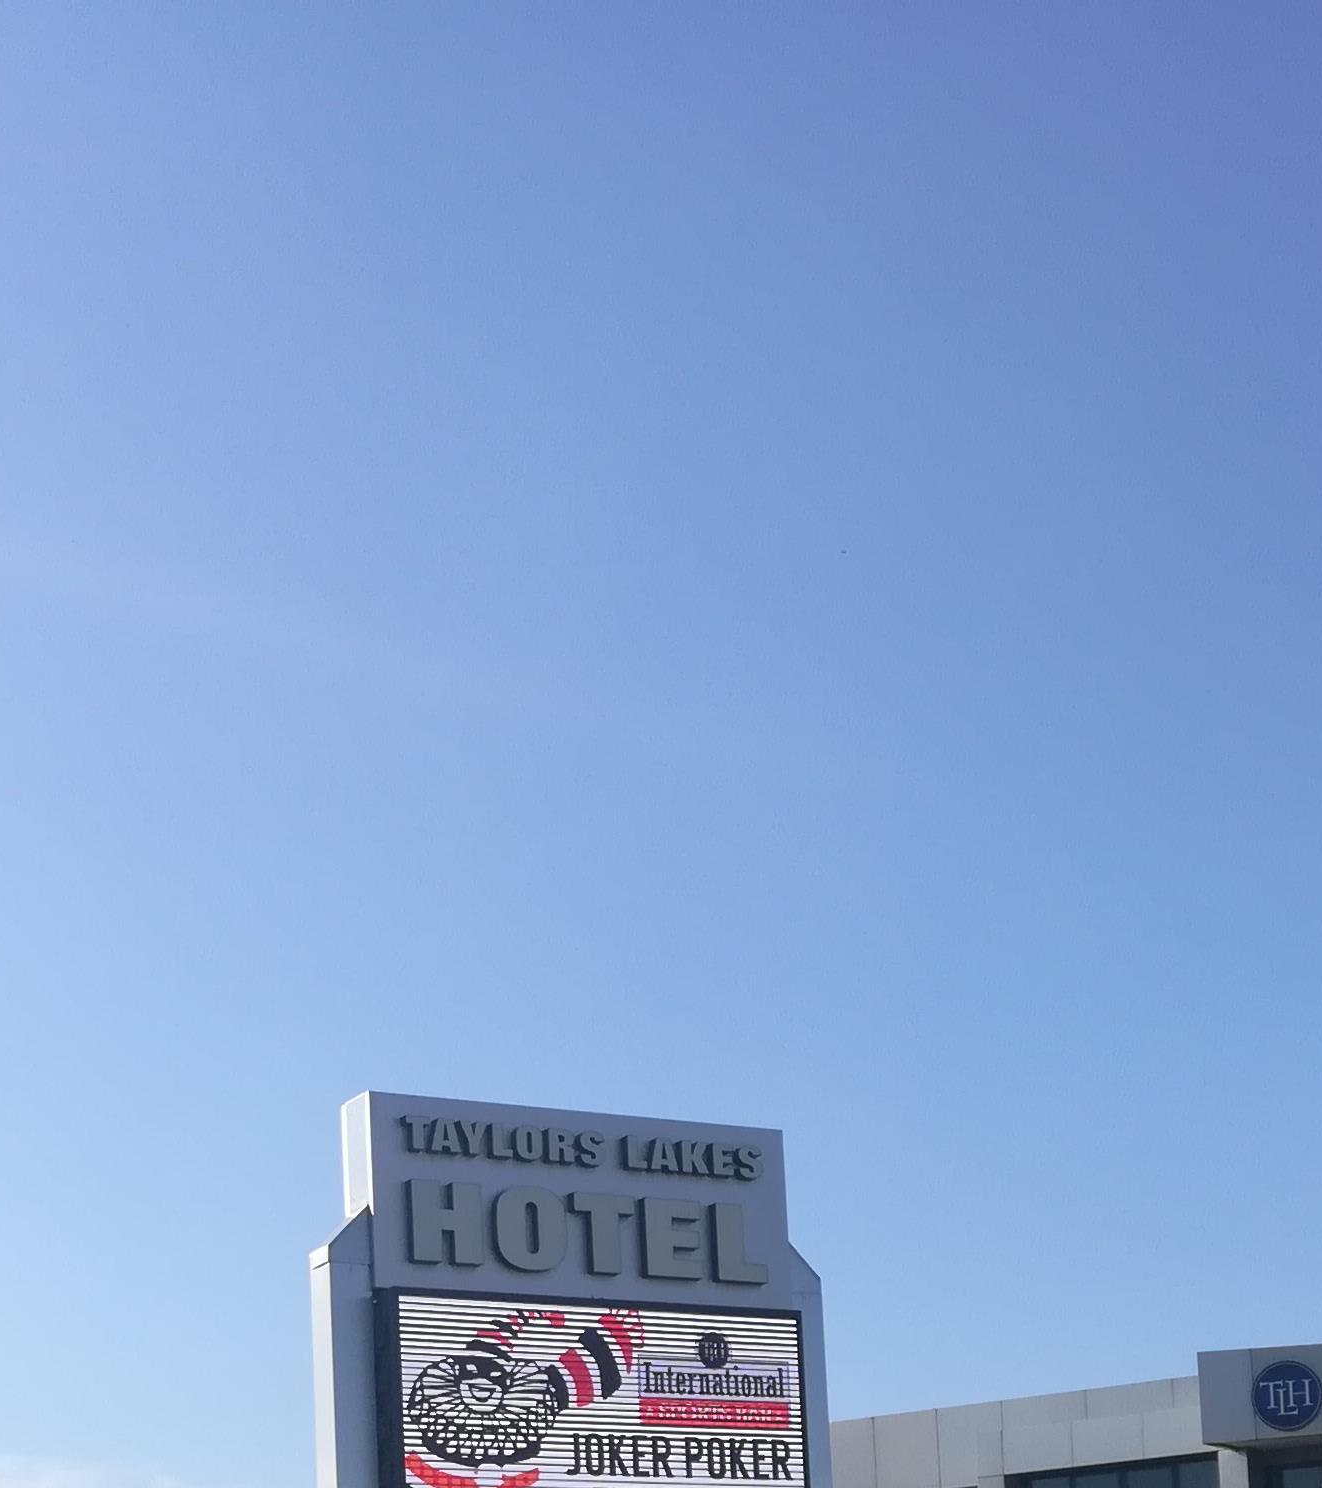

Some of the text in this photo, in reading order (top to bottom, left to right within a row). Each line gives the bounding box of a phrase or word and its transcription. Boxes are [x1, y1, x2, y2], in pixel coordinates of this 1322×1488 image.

[400, 1114, 764, 1181] TAYLORS LAKES
[404, 1178, 769, 1286] HOTEL
[643, 1361, 784, 1398] International
[1259, 1379, 1315, 1417] TLH
[566, 1433, 794, 1480] JOKER POKER
